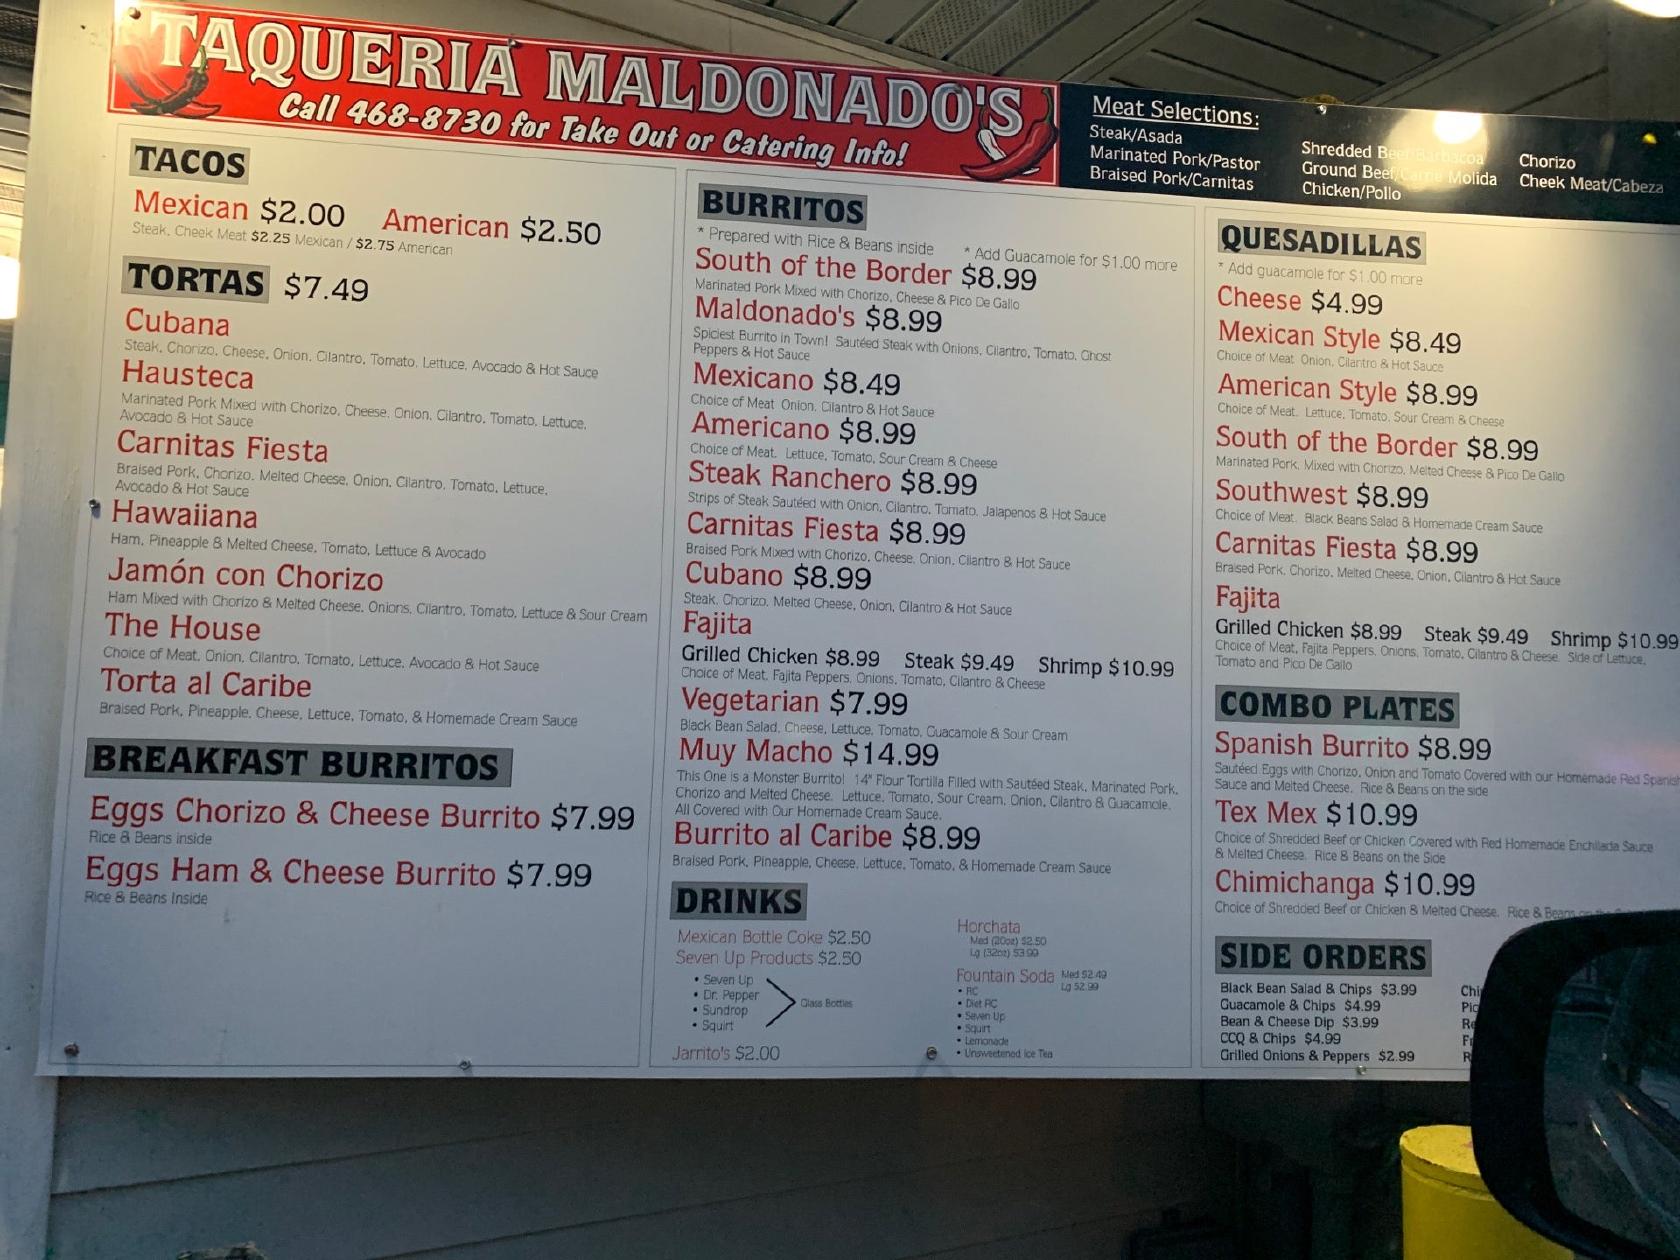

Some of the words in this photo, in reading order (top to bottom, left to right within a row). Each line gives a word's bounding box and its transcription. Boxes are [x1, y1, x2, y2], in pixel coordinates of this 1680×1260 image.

[150, 13, 521, 97] TAQUERIA
[546, 50, 1024, 137] MALDONADO'S
[1093, 95, 1145, 117] Meat
[1151, 100, 1260, 126] Selections:
[279, 93, 340, 122] Call
[346, 100, 501, 135] 468-8730
[509, 111, 550, 138] for
[560, 115, 618, 144] Take
[628, 121, 678, 148] Out
[686, 132, 713, 152] or
[723, 130, 833, 168] Catering
[844, 139, 911, 167] Info!
[1089, 124, 1182, 144] Steak/Asada
[134, 144, 245, 178] TACOS
[1090, 144, 1166, 164] Marinated
[1172, 150, 1260, 170] Pork/Pastor
[1301, 140, 1371, 158] Shredded
[1519, 153, 1576, 169] Chorizo
[1090, 165, 1146, 183] Braised
[1153, 170, 1253, 190] Pork/Carnitas
[1302, 160, 1356, 177] Ground
[1448, 171, 1498, 187] Molida
[1519, 173, 1565, 189] Cheek
[1570, 176, 1663, 193] Meat/Cabeza
[1302, 181, 1401, 200] Chicken/Pollo
[134, 189, 247, 220] Mexican
[260, 197, 344, 227] $2.00
[382, 208, 508, 238] American
[520, 215, 601, 245] $2.50
[703, 189, 863, 224] BURRITOS
[132, 222, 169, 236] Steak,
[175, 225, 212, 238] Cheek
[217, 228, 246, 240] Meat
[251, 229, 290, 244] $2.25
[295, 234, 342, 248] Mexican
[355, 237, 394, 251] $2.75
[397, 241, 452, 255] American
[709, 226, 769, 244] Prepared
[774, 233, 802, 246] with
[807, 233, 835, 248] Rice
[838, 235, 850, 249] &
[854, 236, 892, 252] Beans
[897, 241, 933, 255] inside
[1221, 224, 1421, 259] QUESADILLAS
[128, 262, 263, 296] TORTAS
[695, 247, 770, 273] South
[781, 254, 808, 276] of
[815, 256, 855, 279] the
[866, 258, 952, 285] Border
[961, 262, 1036, 291] $8.99
[284, 273, 368, 302] $7.49
[1218, 285, 1301, 310] Cheese
[1311, 289, 1382, 315] $4.99
[125, 307, 229, 336] Cubana
[1219, 319, 1313, 346] Mexican
[1324, 325, 1380, 352] Style
[1389, 327, 1461, 354] $8.49
[124, 339, 162, 353] Steak,
[166, 341, 218, 356] Chorizo,
[222, 344, 269, 360] Cheese,
[273, 347, 311, 362] Onion,
[316, 350, 365, 365] Cilantro,
[370, 352, 417, 368] Tomato,
[423, 356, 467, 371] Lettuce,
[471, 359, 522, 374] Avocado
[525, 362, 535, 374] &
[539, 363, 560, 376] Hot
[563, 365, 598, 379] Sauce
[122, 359, 253, 389] Hausteca
[112, 499, 256, 528] Hawaiiana
[108, 557, 204, 584] Jamón
[216, 567, 264, 586] con
[277, 563, 383, 591] Chorizo
[104, 612, 158, 637] The
[170, 614, 260, 641] House
[683, 610, 751, 639] Fajita
[682, 644, 740, 662] Grilled
[747, 646, 817, 664] Chicken
[825, 648, 879, 667] $8.99
[904, 652, 954, 669] Steak
[960, 652, 1014, 671] $9.49
[1038, 656, 1102, 679] Shrimp
[1108, 657, 1174, 677] $10.99
[1220, 690, 1331, 718] COMBO
[1343, 695, 1454, 722] PLATES
[679, 738, 736, 766] Muy
[746, 739, 832, 763] Macho
[843, 741, 938, 766] $14.99
[1215, 730, 1312, 759] Spanish
[1322, 734, 1409, 758] Burrito
[1418, 734, 1491, 761] $8.99
[93, 745, 308, 776] BREAKFAST
[320, 750, 498, 781] BURRITOS
[90, 795, 163, 827] Eggs
[176, 797, 285, 823] Chorizo
[296, 800, 318, 824] &
[330, 800, 429, 827] Cheese
[441, 803, 539, 829] Burrito
[551, 802, 634, 831] $7.99
[1215, 800, 1256, 822] Tex
[1268, 801, 1316, 823] Mex
[1326, 801, 1417, 827] $10.99
[674, 821, 769, 845] Burrito
[779, 823, 799, 845] al
[811, 823, 891, 848] Caribe
[902, 825, 980, 851] $8.99
[1215, 868, 1374, 900] Chimichanga
[1384, 869, 1474, 897] $10.99
[676, 888, 801, 914] DRINKS
[677, 929, 736, 944] Mexican
[742, 929, 782, 944] Bottle
[787, 929, 822, 944] Coke
[827, 929, 871, 945] $2.50
[957, 918, 1020, 934] Horchata
[1221, 942, 1290, 969] SIDE
[1303, 943, 1426, 970] ORDERS
[956, 968, 1015, 983] Fountain
[1019, 968, 1054, 983] Soda
[1220, 982, 1252, 993] Black
[1256, 982, 1286, 993] Bean
[1290, 982, 1321, 994] Salad
[1325, 982, 1335, 994] &
[1339, 983, 1372, 996] Chips
[1380, 983, 1416, 996] $3.99
[702, 1004, 748, 1018] Sundrop
[703, 989, 718, 1001] Dr.
[722, 989, 760, 1004] Pepper
[1220, 998, 1285, 1011] Guacamole
[1289, 999, 1298, 1011] &
[1303, 999, 1335, 1013] Chips
[1344, 999, 1380, 1011] $4.99
[1220, 1015, 1249, 1026] Bean
[1254, 1015, 1264, 1026] &
[1267, 1015, 1310, 1027] Cheese
[1314, 1016, 1334, 1030] Dip
[1342, 1016, 1378, 1028] $3.99
[672, 1045, 729, 1060] Jarrito's
[735, 1045, 780, 1061] $2.00
[1220, 1032, 1245, 1046] CCQ
[1249, 1032, 1258, 1044] &
[1262, 1032, 1296, 1046] Chips
[1304, 1032, 1341, 1045] $4.99
[1220, 1049, 1258, 1060] Grilled
[1263, 1049, 1304, 1061] Onions
[1308, 1050, 1318, 1061] &
[1323, 1050, 1369, 1063] Peppers
[1378, 1050, 1414, 1062] $2.99
